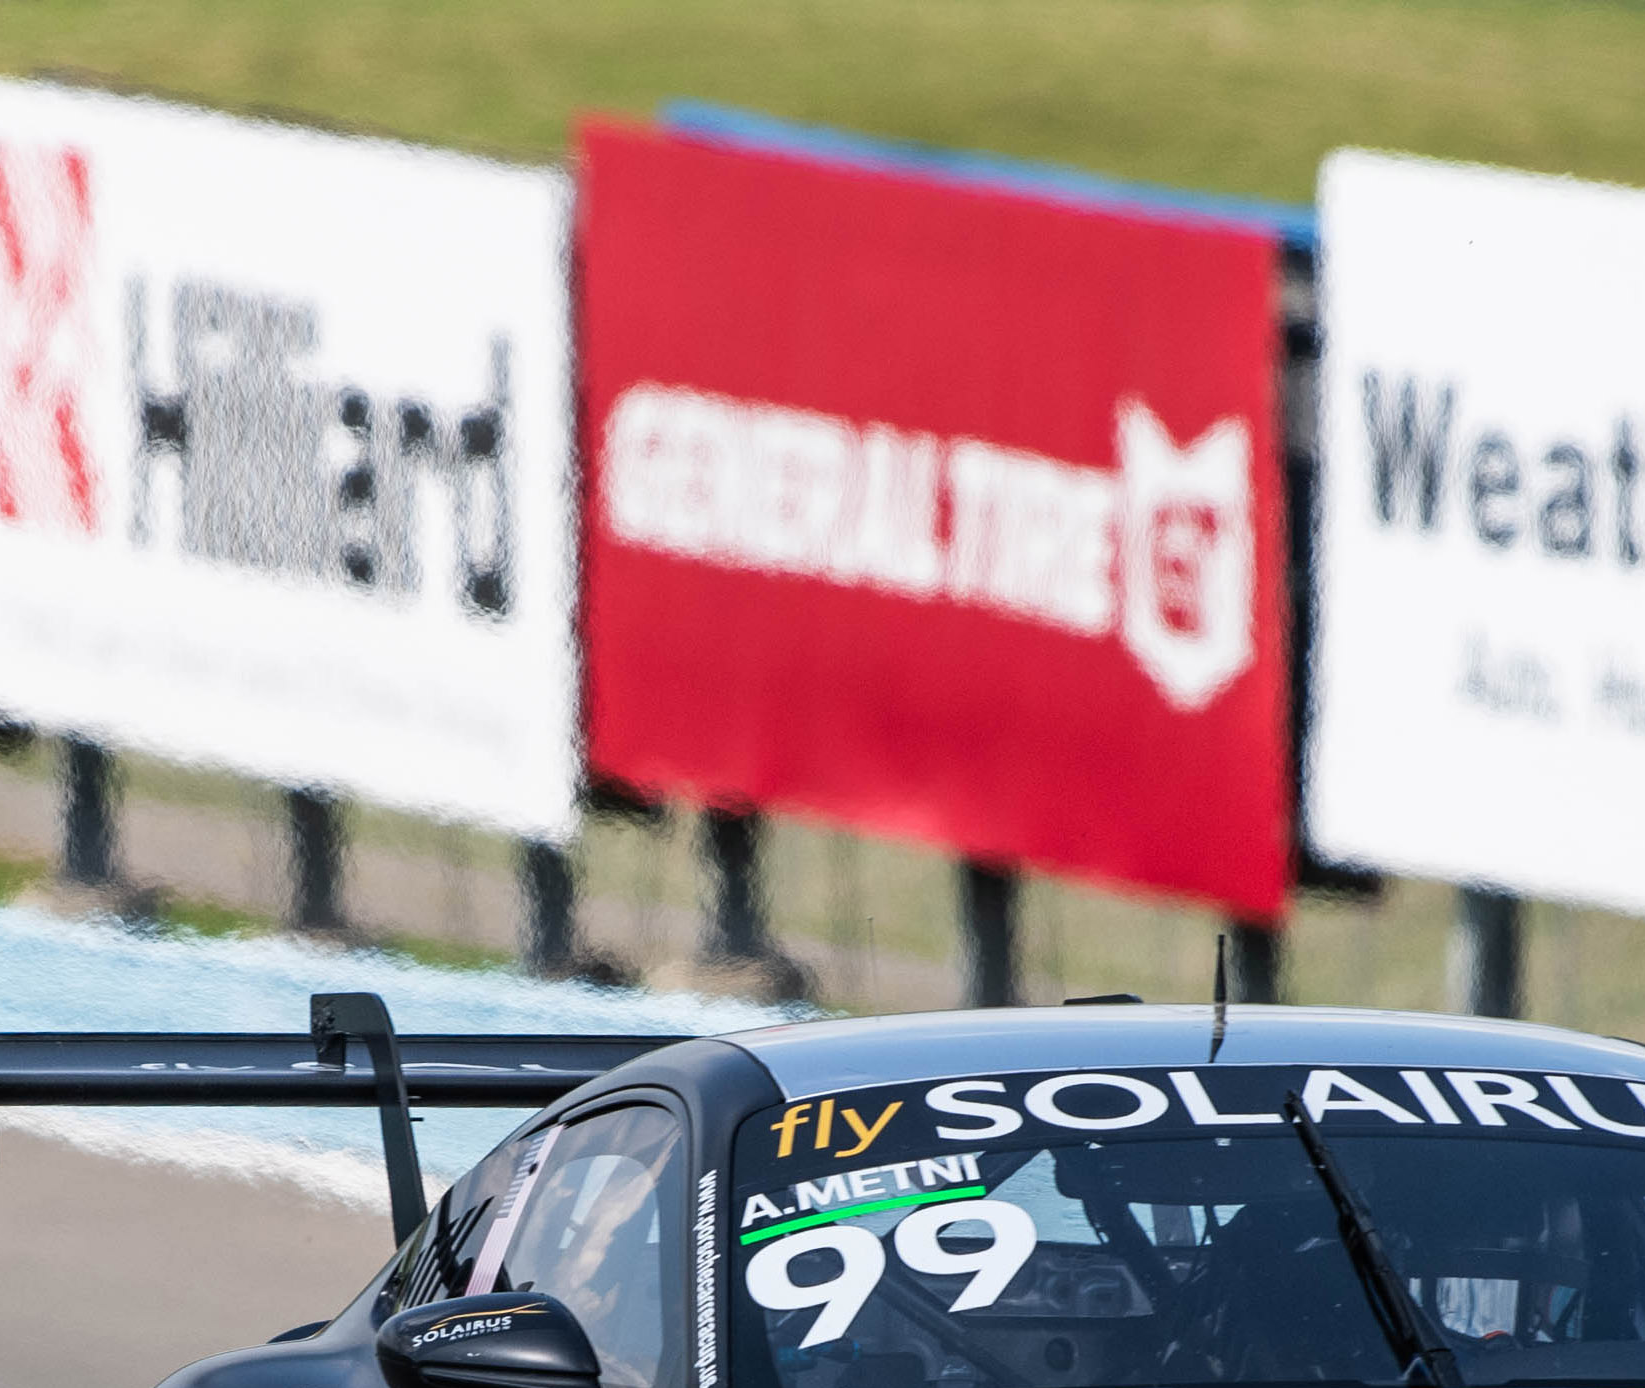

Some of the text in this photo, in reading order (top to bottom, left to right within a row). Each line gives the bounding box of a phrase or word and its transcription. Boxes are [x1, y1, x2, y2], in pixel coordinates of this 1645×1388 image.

[770, 1098, 904, 1158] fly
[740, 1151, 987, 1228] A.METNI
[744, 1199, 1038, 1350] 99
[412, 1315, 512, 1348] SOLAIRUS
